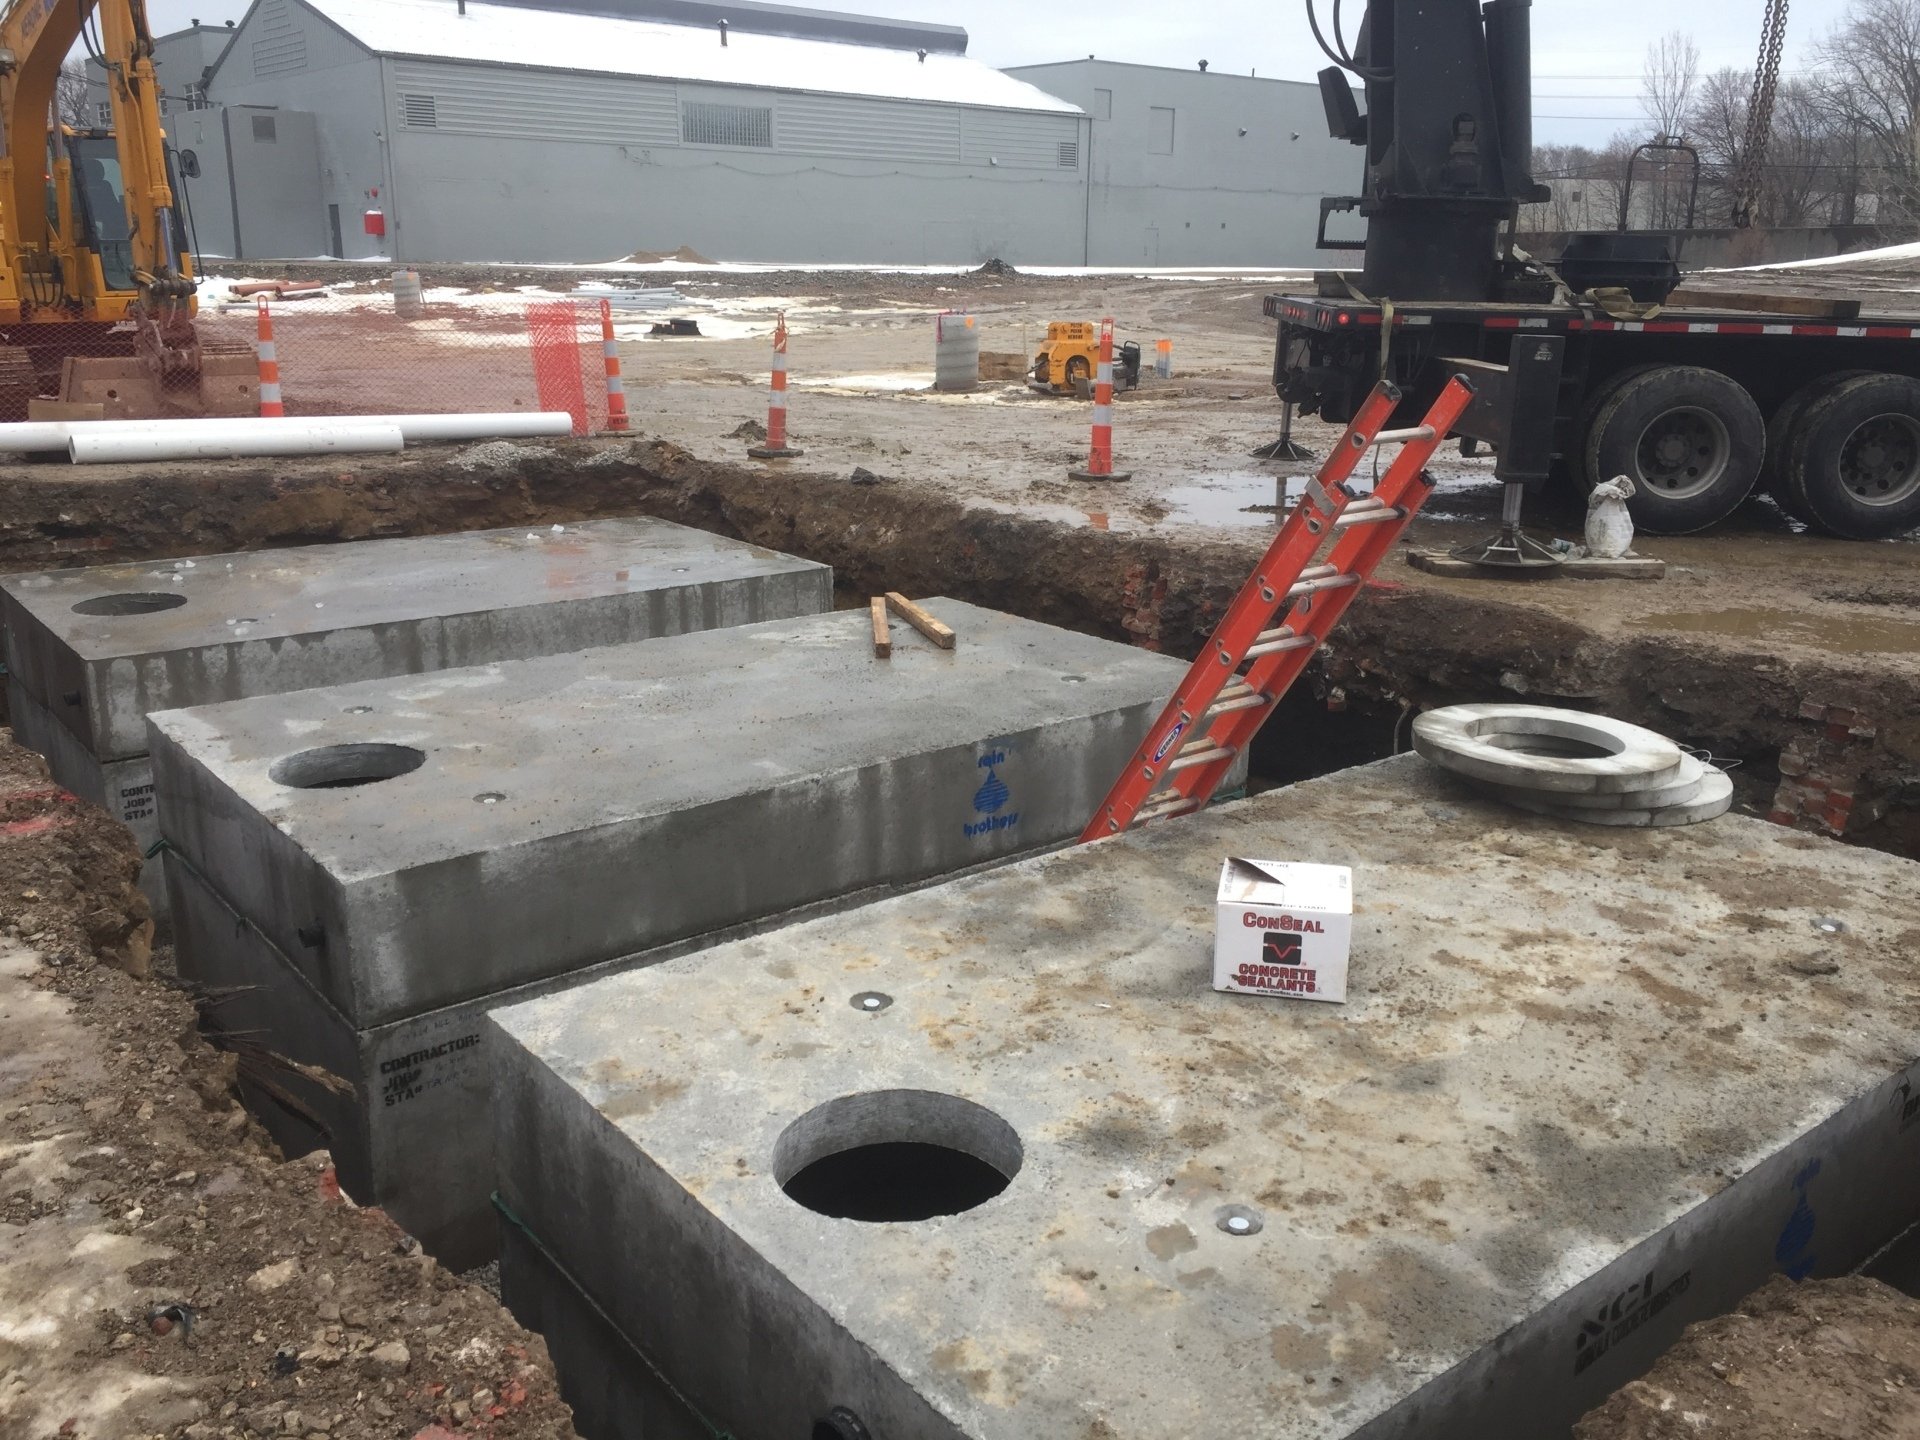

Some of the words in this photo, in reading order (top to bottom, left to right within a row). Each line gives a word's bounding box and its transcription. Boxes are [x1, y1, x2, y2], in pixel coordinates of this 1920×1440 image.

[1239, 963, 1316, 981] CONCRETE
[1237, 975, 1316, 993] SEALANTS
[380, 1034, 480, 1075] CONTRACTOR:
